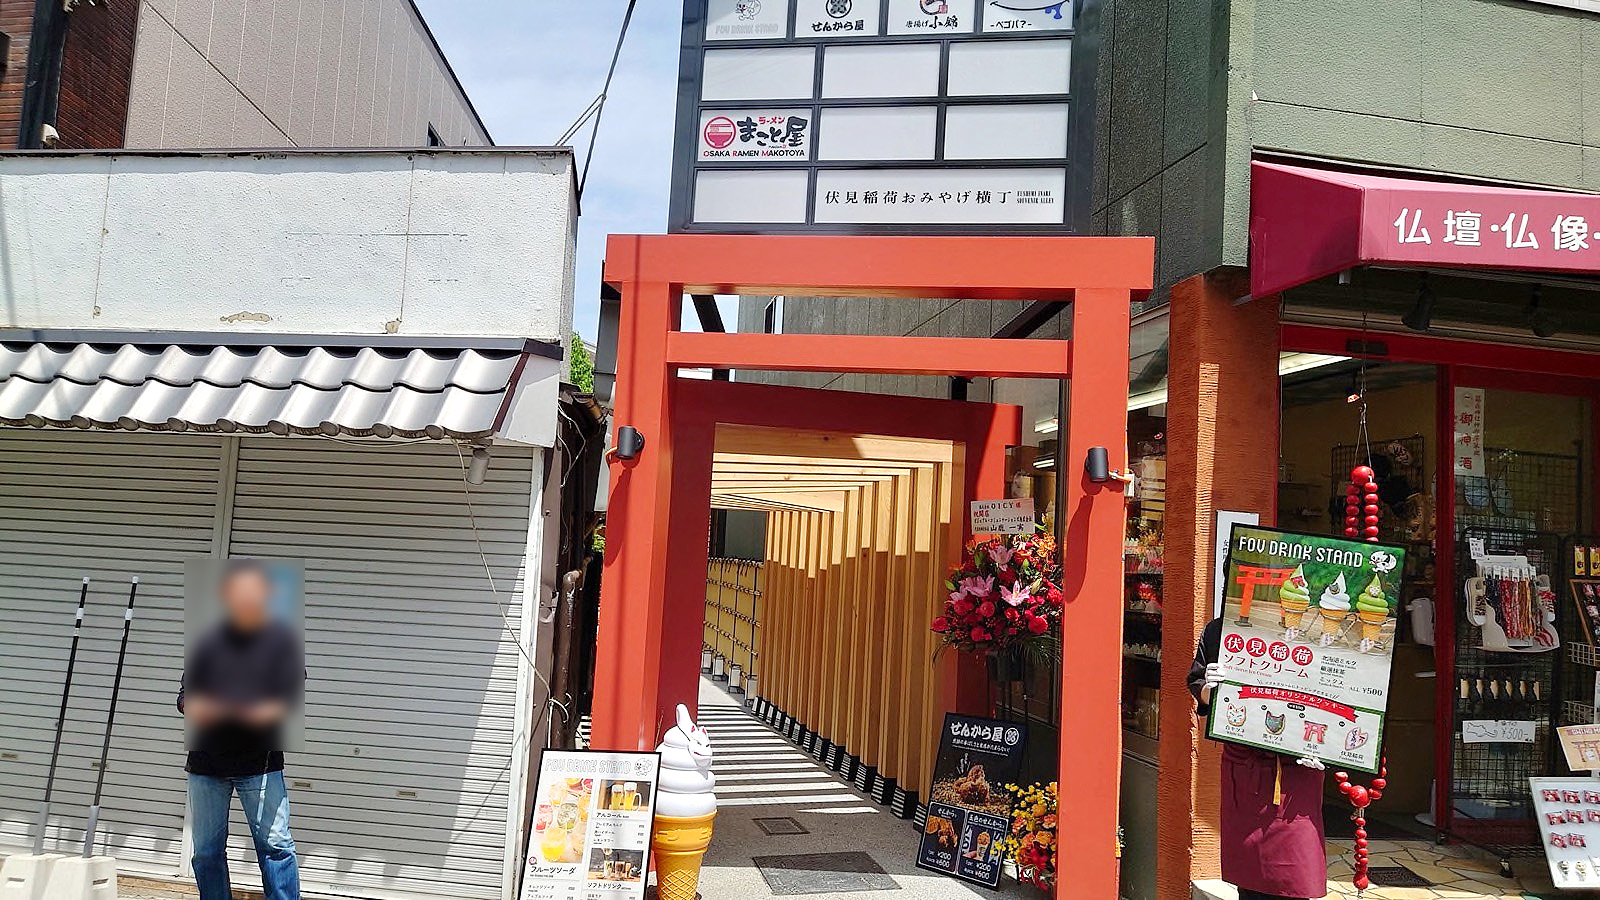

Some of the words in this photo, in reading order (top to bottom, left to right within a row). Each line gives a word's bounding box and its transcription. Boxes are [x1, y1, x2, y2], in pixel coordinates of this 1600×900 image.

[811, 19, 865, 32] せんから屋
[757, 116, 786, 125] ラーメン
[736, 116, 809, 148] まこと屋
[824, 189, 1012, 205] 伏見稲荷おみやげ横丁
[1238, 536, 1267, 554] FOV
[1268, 541, 1313, 561] DRINK
[1315, 547, 1363, 568] STAND
[1226, 636, 1311, 664] 伏見稲荷
[1224, 654, 1309, 679] ソフトクリーム
[1362, 687, 1383, 697] ¥500
[951, 722, 1004, 743] せんから屋
[531, 865, 577, 875] フルーツソーダ
[587, 882, 622, 891] ソフトドリンク
